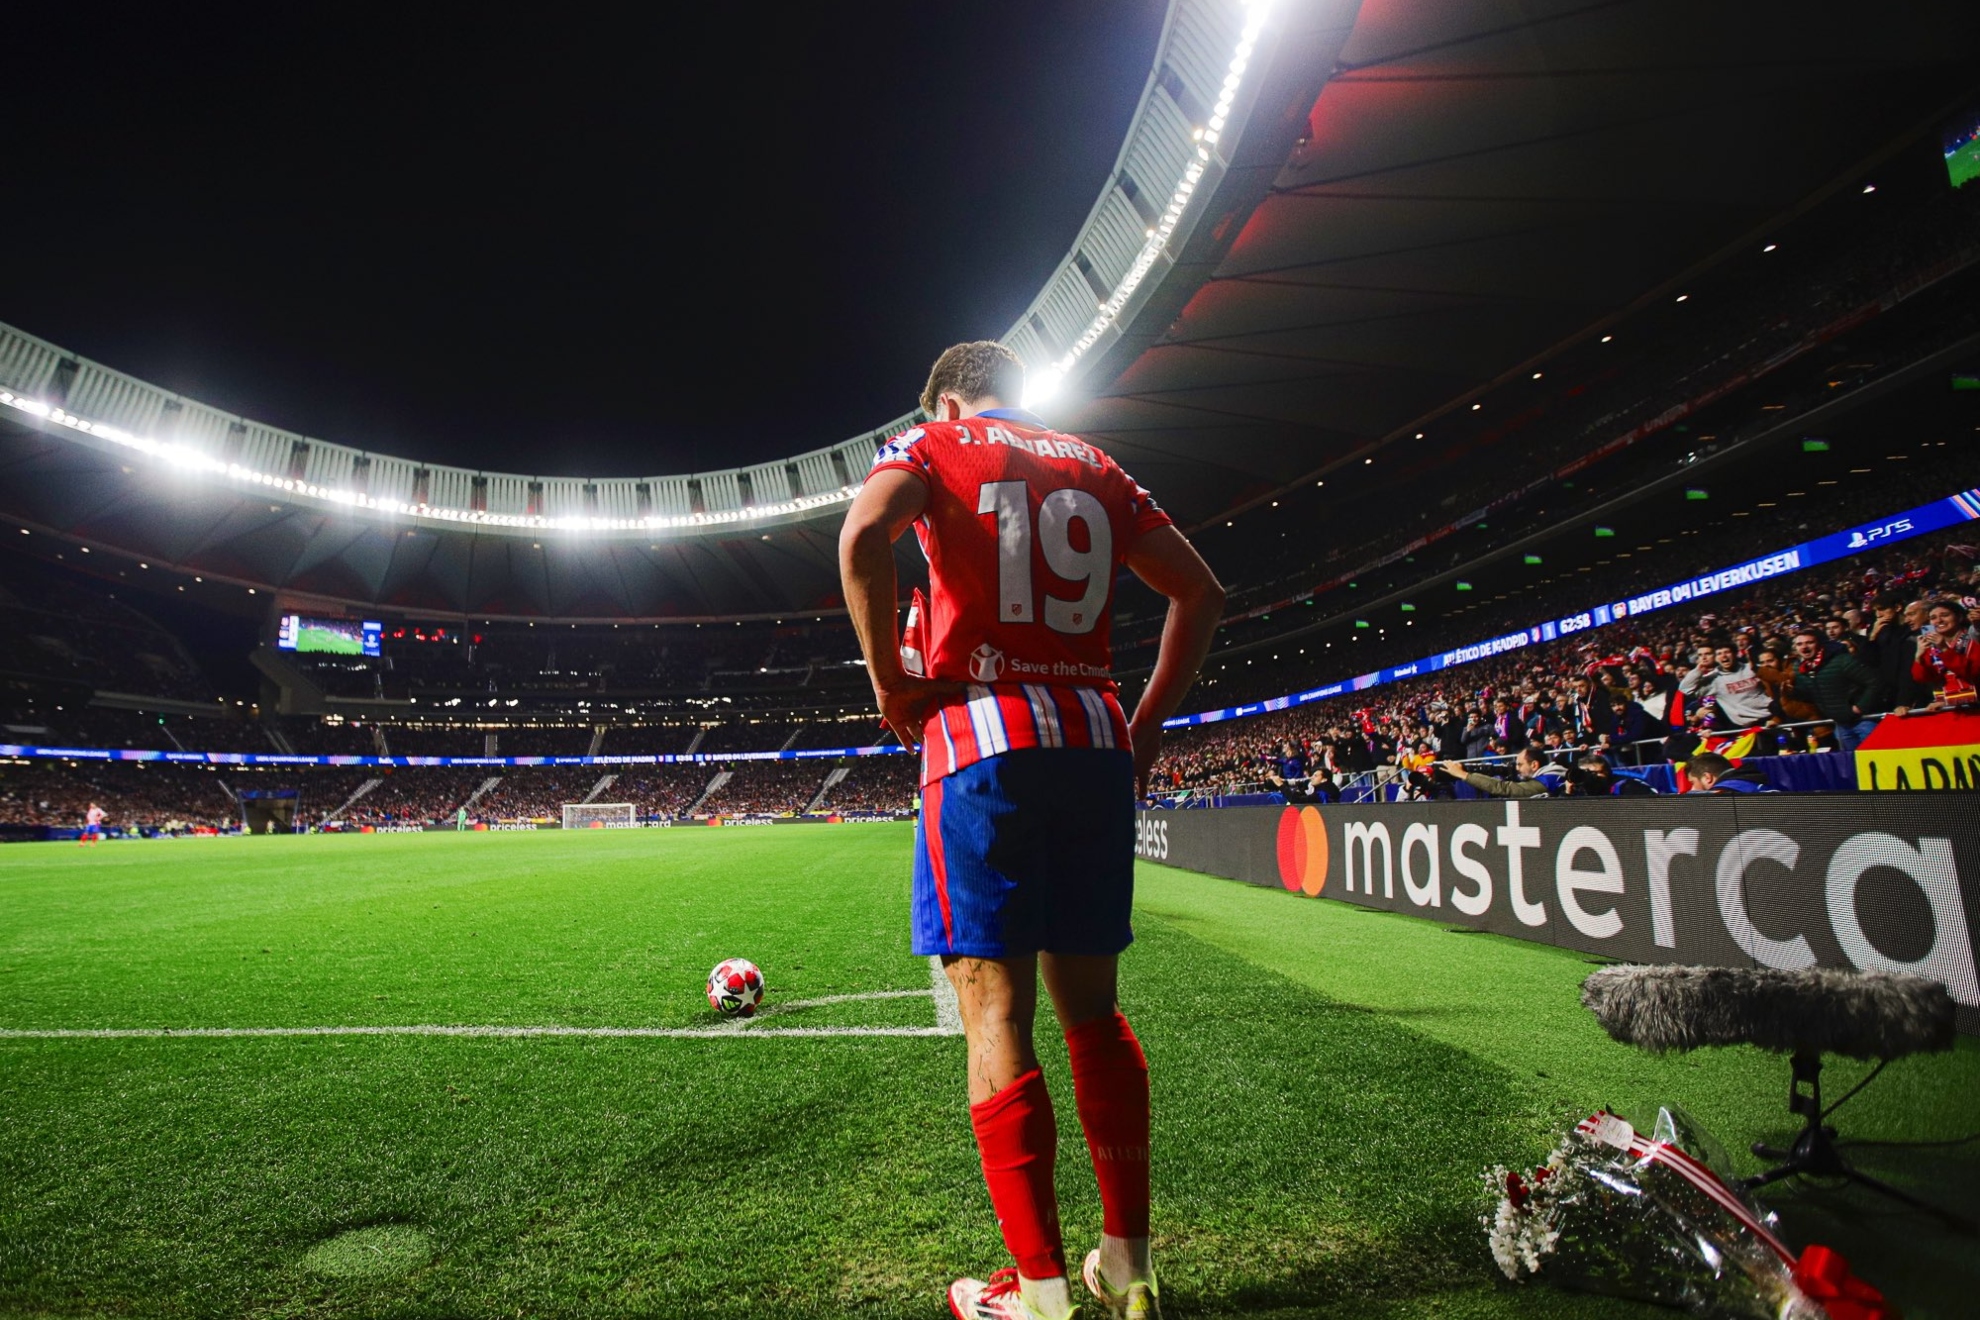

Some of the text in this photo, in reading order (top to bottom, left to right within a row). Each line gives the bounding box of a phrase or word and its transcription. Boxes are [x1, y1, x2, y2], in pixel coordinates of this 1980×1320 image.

[1867, 518, 1914, 541] PS5
[978, 480, 1112, 634] 19
[1479, 642, 1492, 657] DE
[1546, 625, 1552, 638] 1
[1560, 613, 1591, 633] 62:58
[1599, 609, 1606, 623] 1
[1628, 590, 1672, 615] BAYER
[1671, 583, 1692, 602] 04
[1691, 550, 1800, 597] LEVERKUSEN
[1011, 658, 1049, 674] Save
[1053, 661, 1077, 676] the
[489, 822, 537, 832] priceless
[724, 818, 773, 827] priceless
[844, 815, 894, 824] priceless
[376, 824, 423, 834] priceless
[1134, 810, 1168, 859] eless
